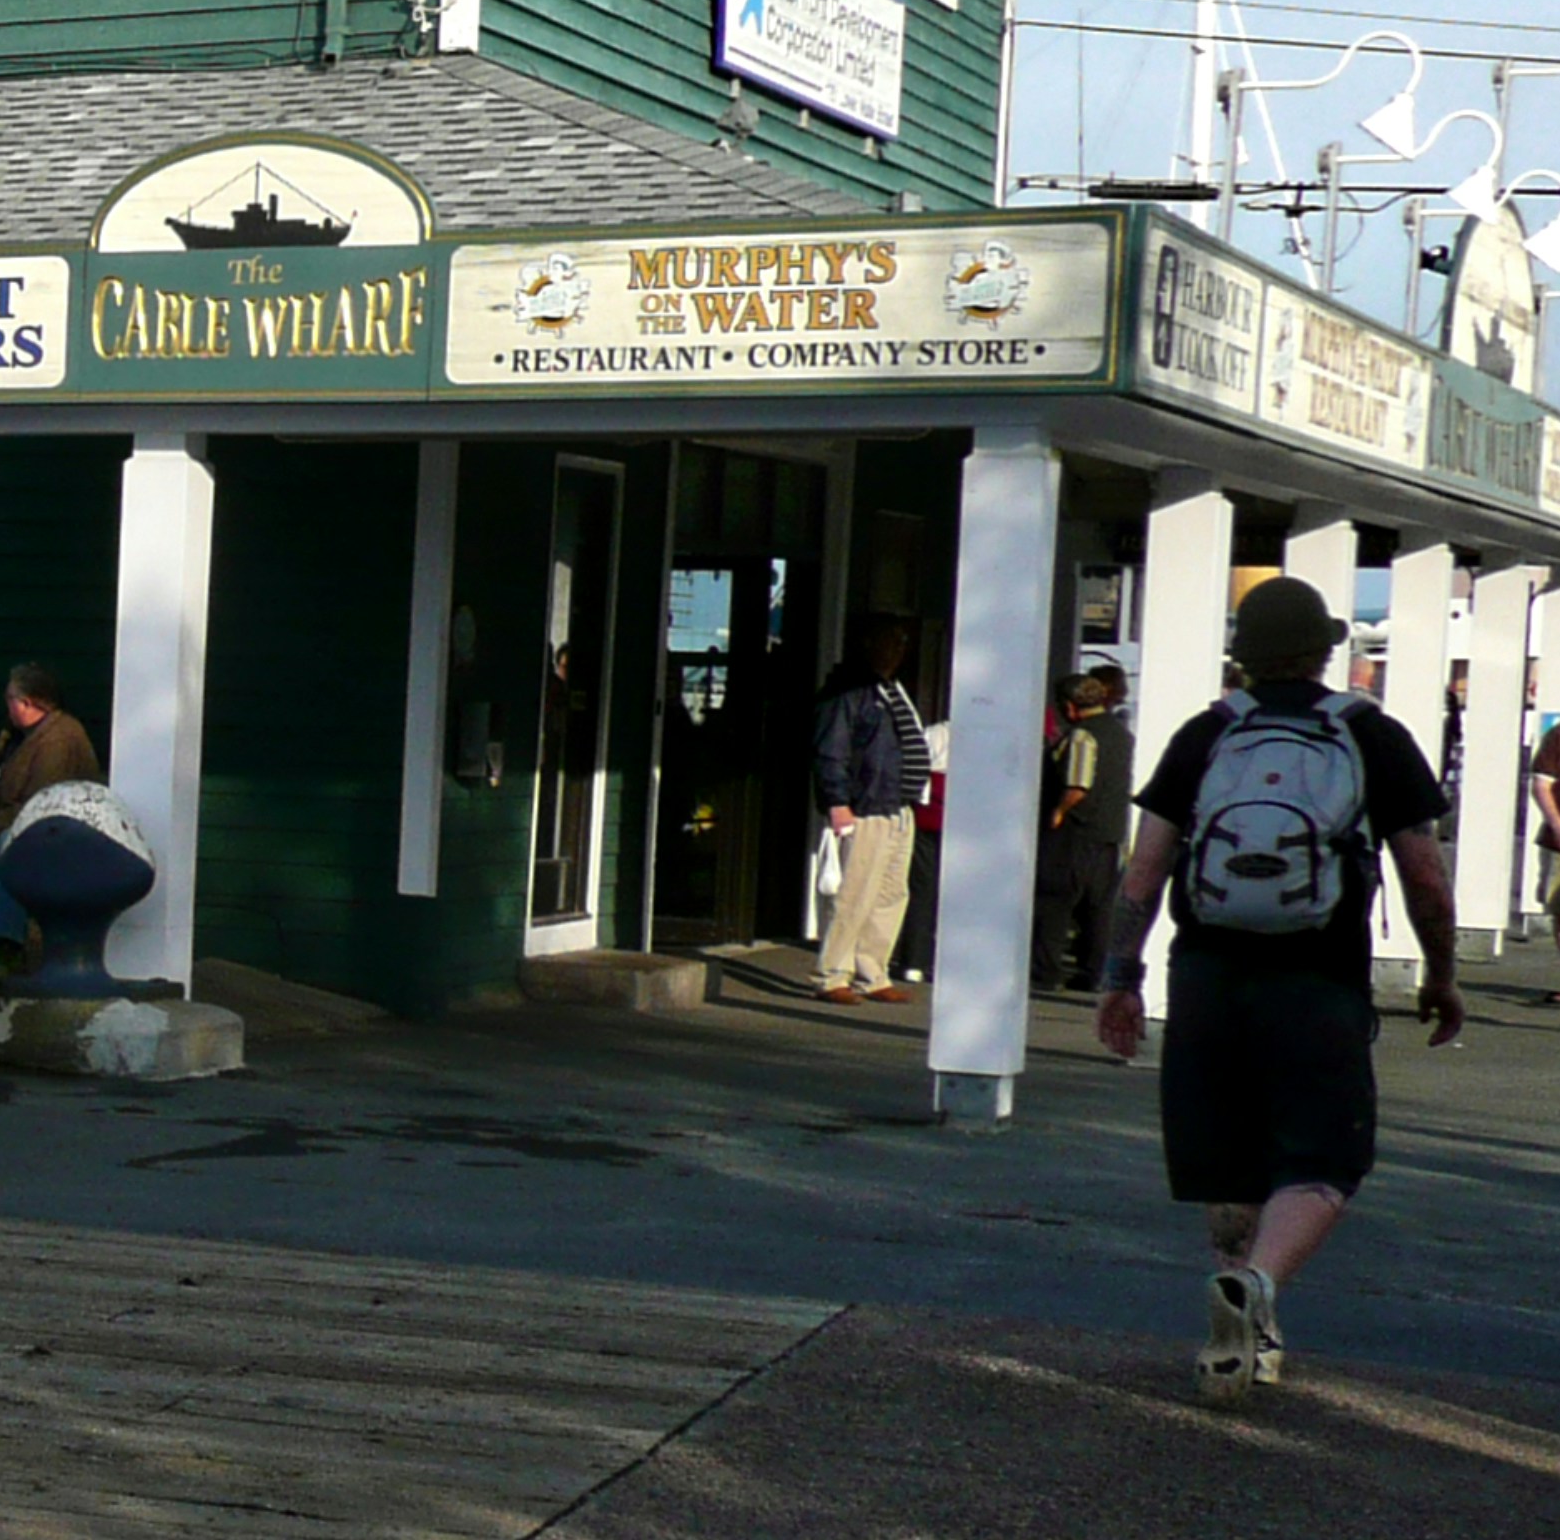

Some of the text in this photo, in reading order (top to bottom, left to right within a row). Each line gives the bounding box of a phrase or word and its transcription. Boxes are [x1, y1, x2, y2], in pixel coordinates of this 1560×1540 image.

[766, 4, 877, 88] Corporation Limited
[228, 254, 284, 286] The
[626, 240, 897, 291] MURPHY'S
[91, 264, 428, 361] CABLE WHARF
[640, 292, 684, 314] ON
[690, 288, 879, 334] WATER
[636, 314, 687, 335] THE
[510, 339, 1030, 374] RESTAURANT COMPANY STORE
